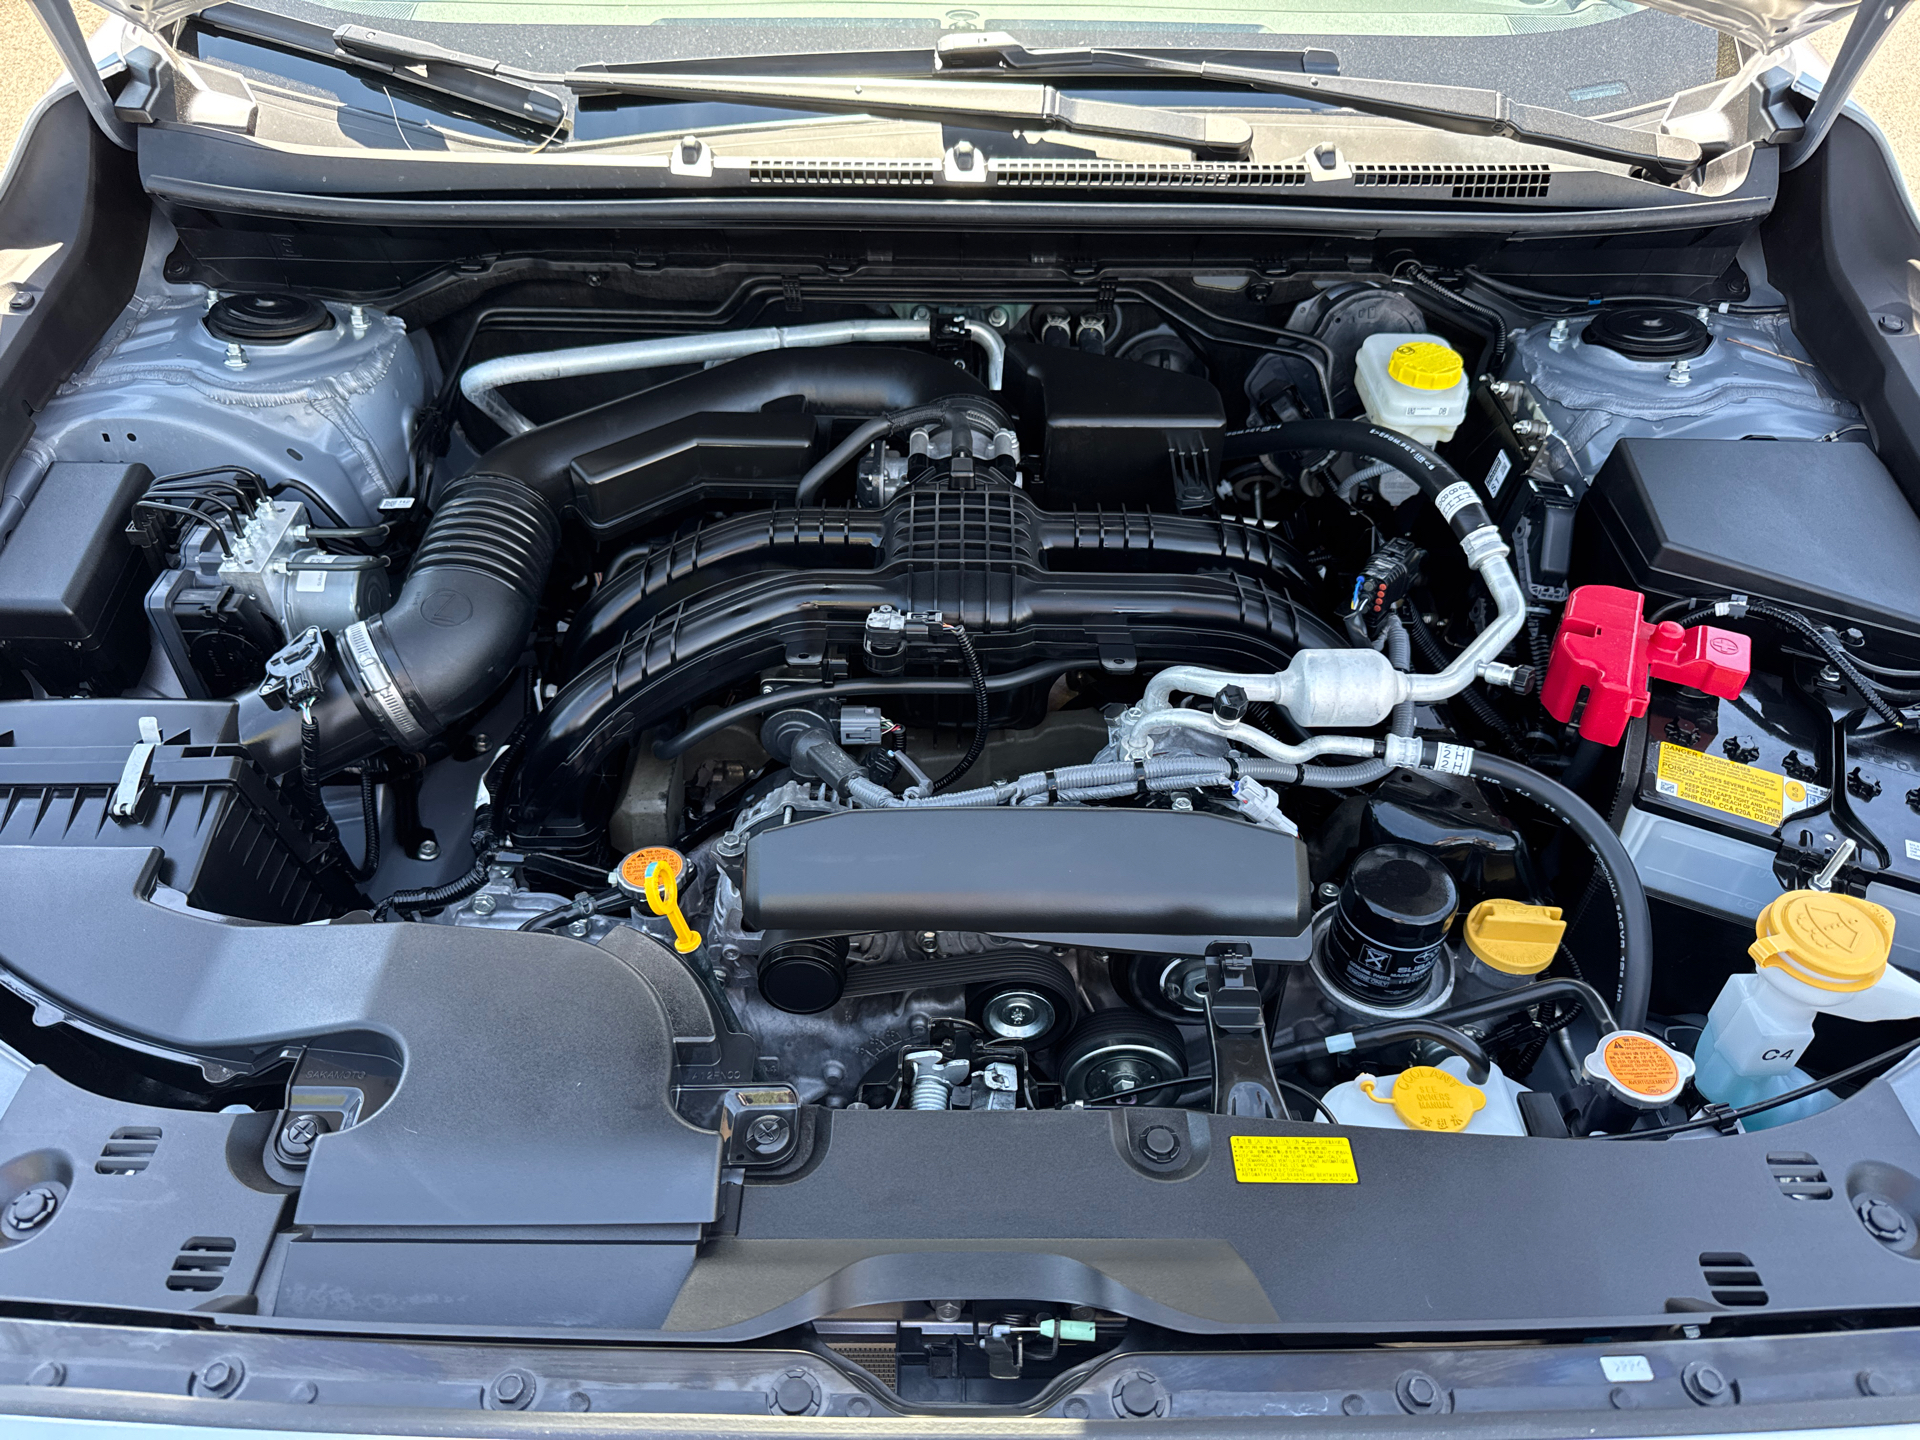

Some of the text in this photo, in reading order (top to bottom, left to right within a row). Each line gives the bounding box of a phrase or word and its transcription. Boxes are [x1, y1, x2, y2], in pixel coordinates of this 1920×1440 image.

[1663, 744, 1698, 758] DANGER
[1701, 754, 1751, 773] EXPLOSIVE GASES
[1662, 762, 1766, 796] POISON CAUSES SEVERE BURNS
[1684, 781, 1699, 790] KEEP
[1701, 785, 1715, 795] VENT
[1716, 790, 1732, 799] CAPS
[1733, 795, 1751, 804] TIGHT
[1750, 800, 1763, 808] AND
[1763, 804, 1781, 814] LEVEL
[1684, 787, 1699, 795] KEEP
[1700, 791, 1711, 799] OUT
[1722, 797, 1742, 807] REACH
[1751, 806, 1780, 819] CHILDREN
[1718, 802, 1734, 812] CCA
[1735, 807, 1752, 817] 620A
[1596, 854, 1618, 898] YOKOHAMA
[1762, 1049, 1795, 1061] C4
[305, 1070, 366, 1080] SAKAMOTO
[1397, 1068, 1460, 1091] COOLANT
[1419, 1086, 1438, 1094] SEE
[1418, 1101, 1454, 1110] MANUAL
